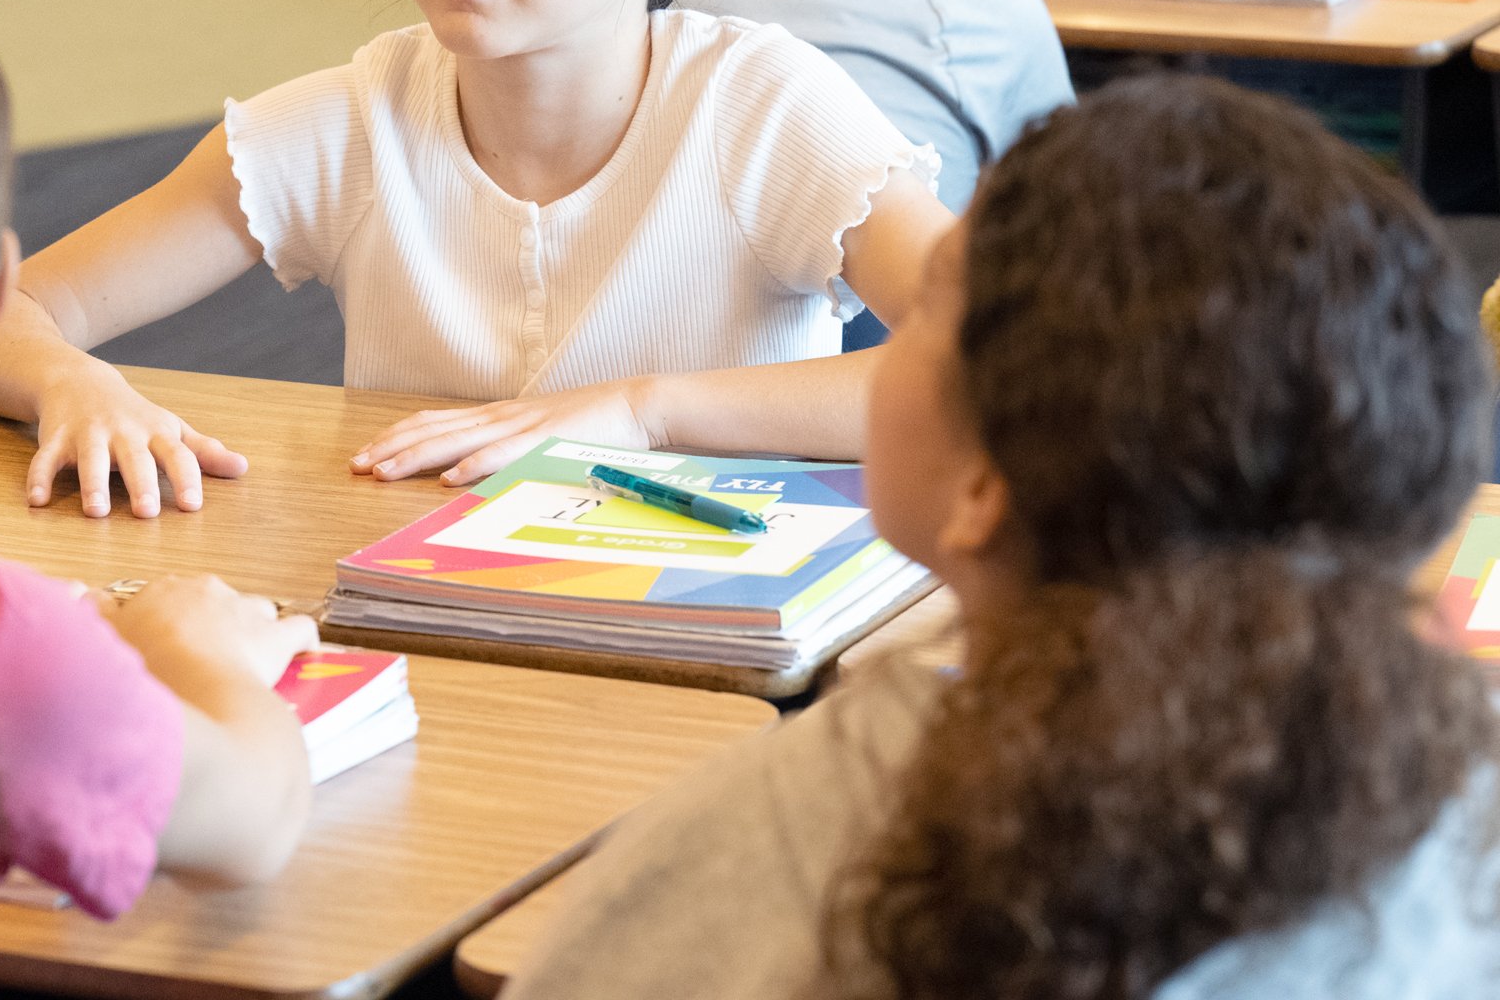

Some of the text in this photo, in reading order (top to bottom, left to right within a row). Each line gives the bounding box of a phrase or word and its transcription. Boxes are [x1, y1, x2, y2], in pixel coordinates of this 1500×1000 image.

[716, 478, 787, 492] FLY
[576, 534, 688, 550] Grade 4
